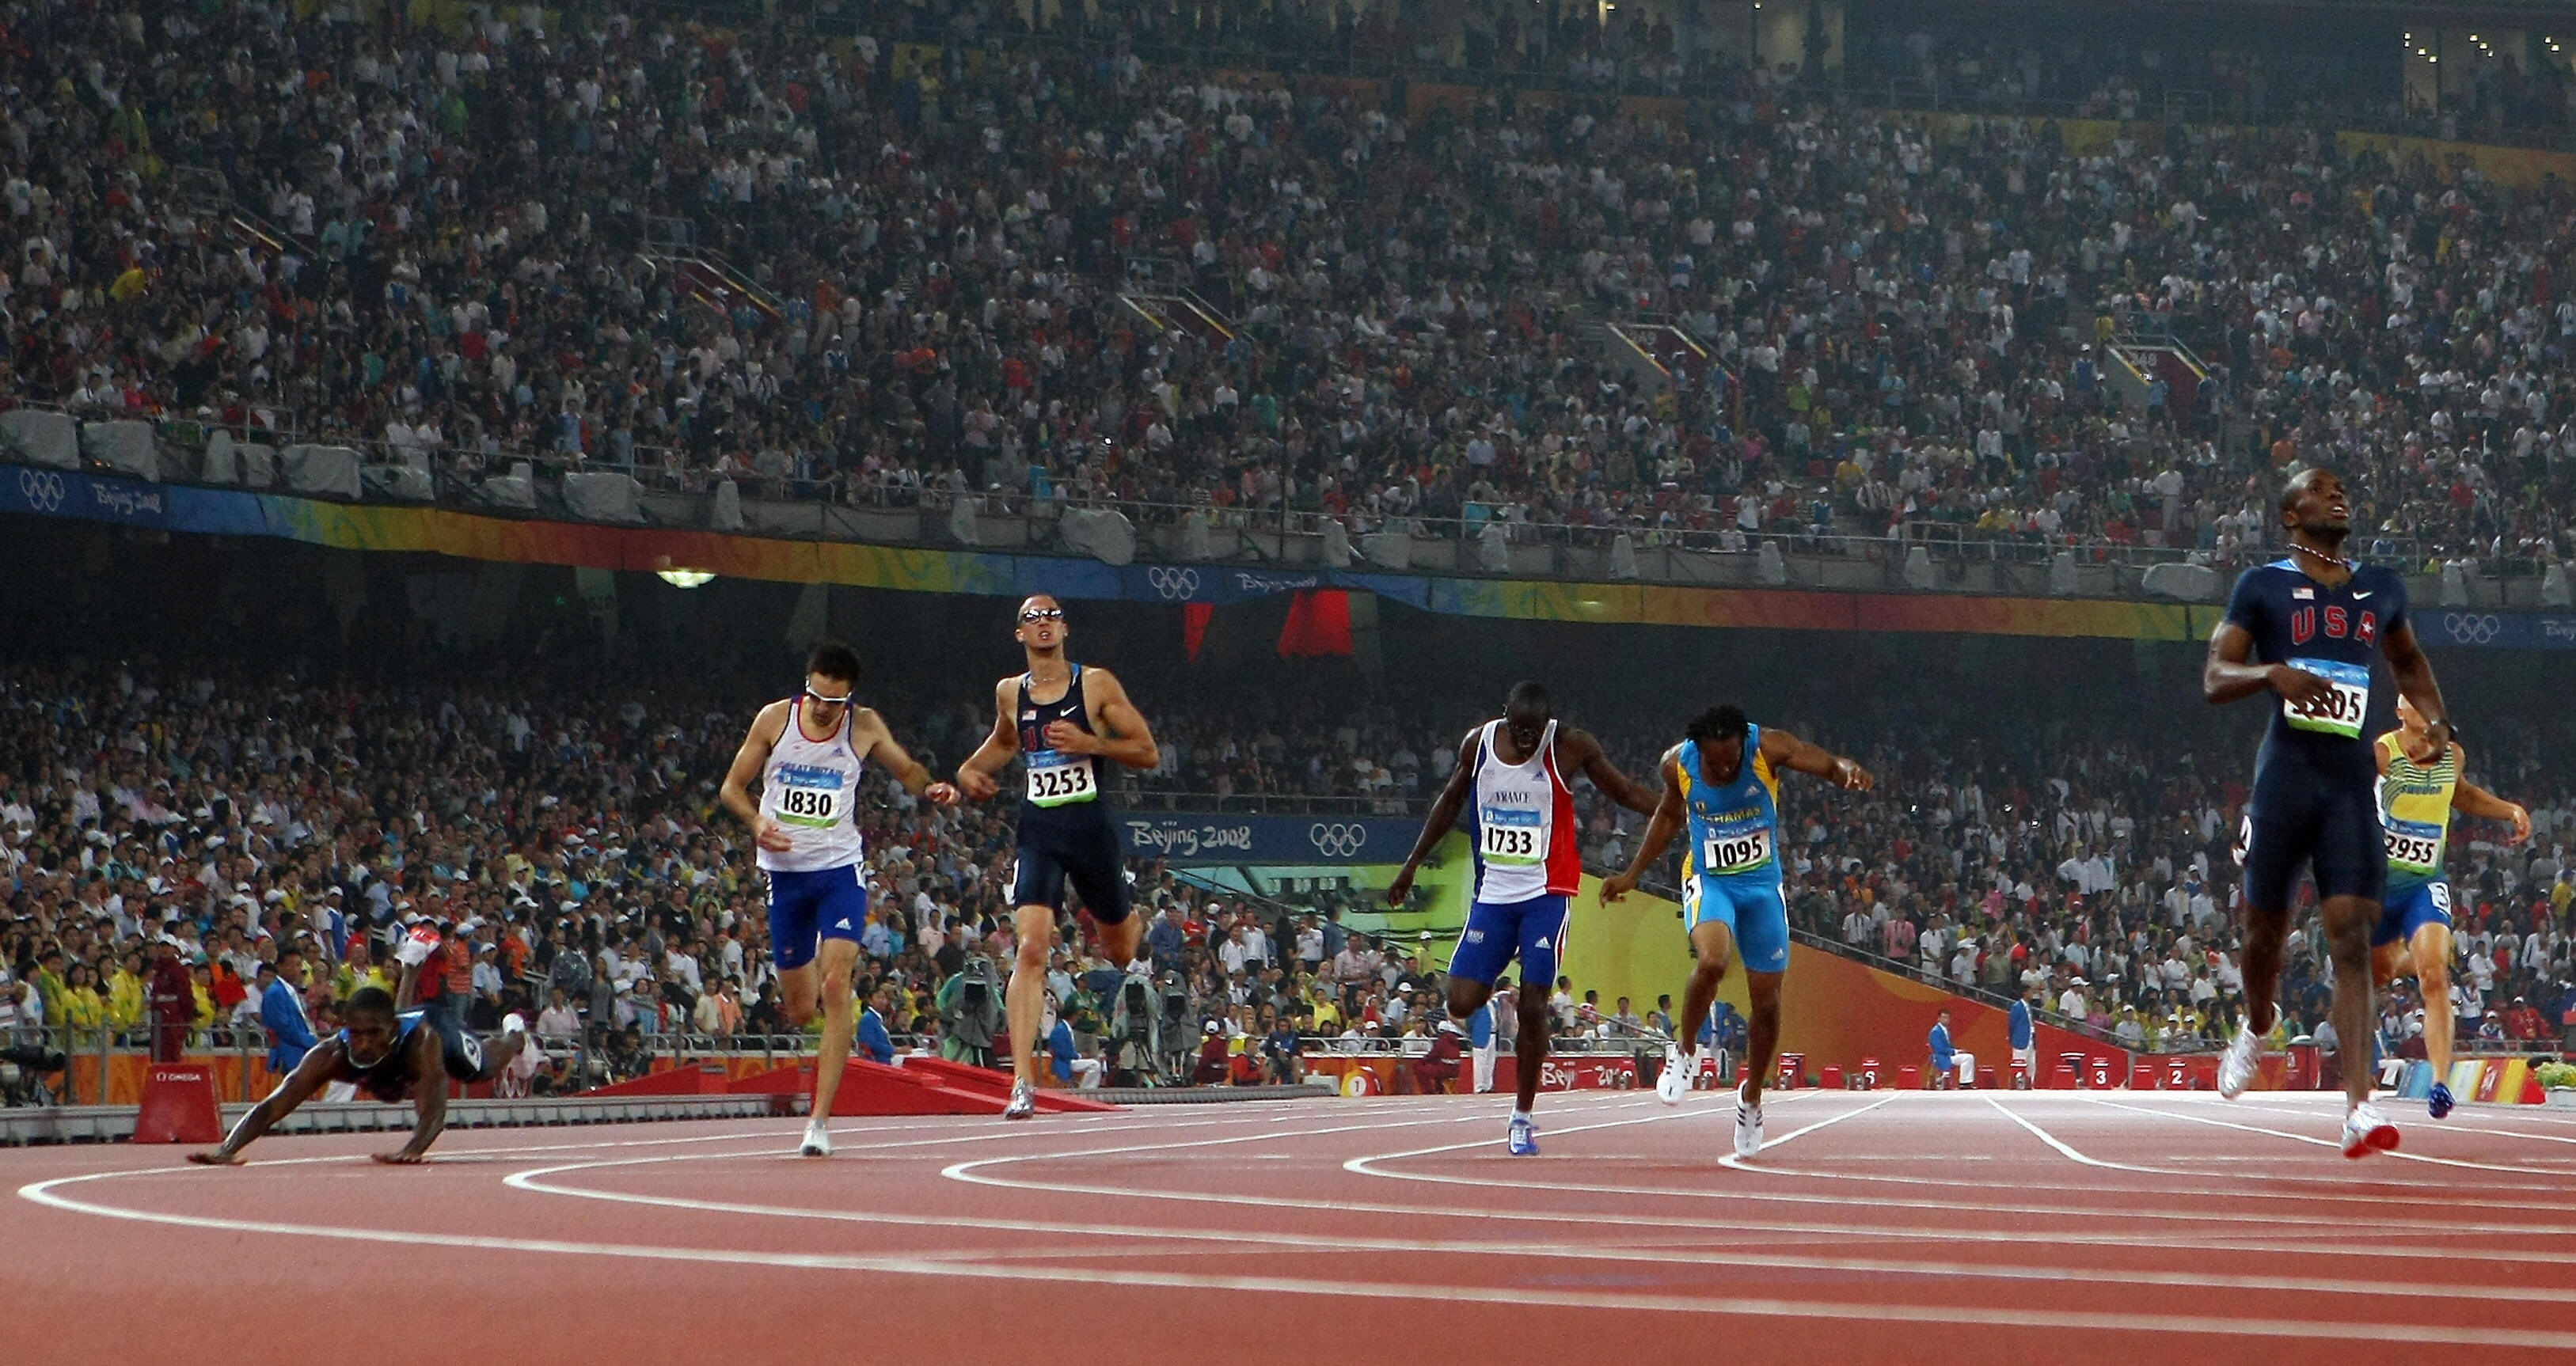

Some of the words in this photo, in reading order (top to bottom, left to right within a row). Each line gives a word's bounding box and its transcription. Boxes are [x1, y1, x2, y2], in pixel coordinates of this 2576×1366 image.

[2292, 605, 2375, 648] USA
[1032, 766, 1089, 798] 3253
[784, 788, 832, 817] 1830
[1126, 821, 1199, 856] Beijing
[1202, 825, 1252, 851] 2008
[1488, 827, 1533, 855] 1733
[1713, 835, 1763, 868] 1095
[2385, 835, 2435, 863] 2955
[2095, 1070, 2107, 1085] 3
[2171, 1070, 2183, 1085] 2
